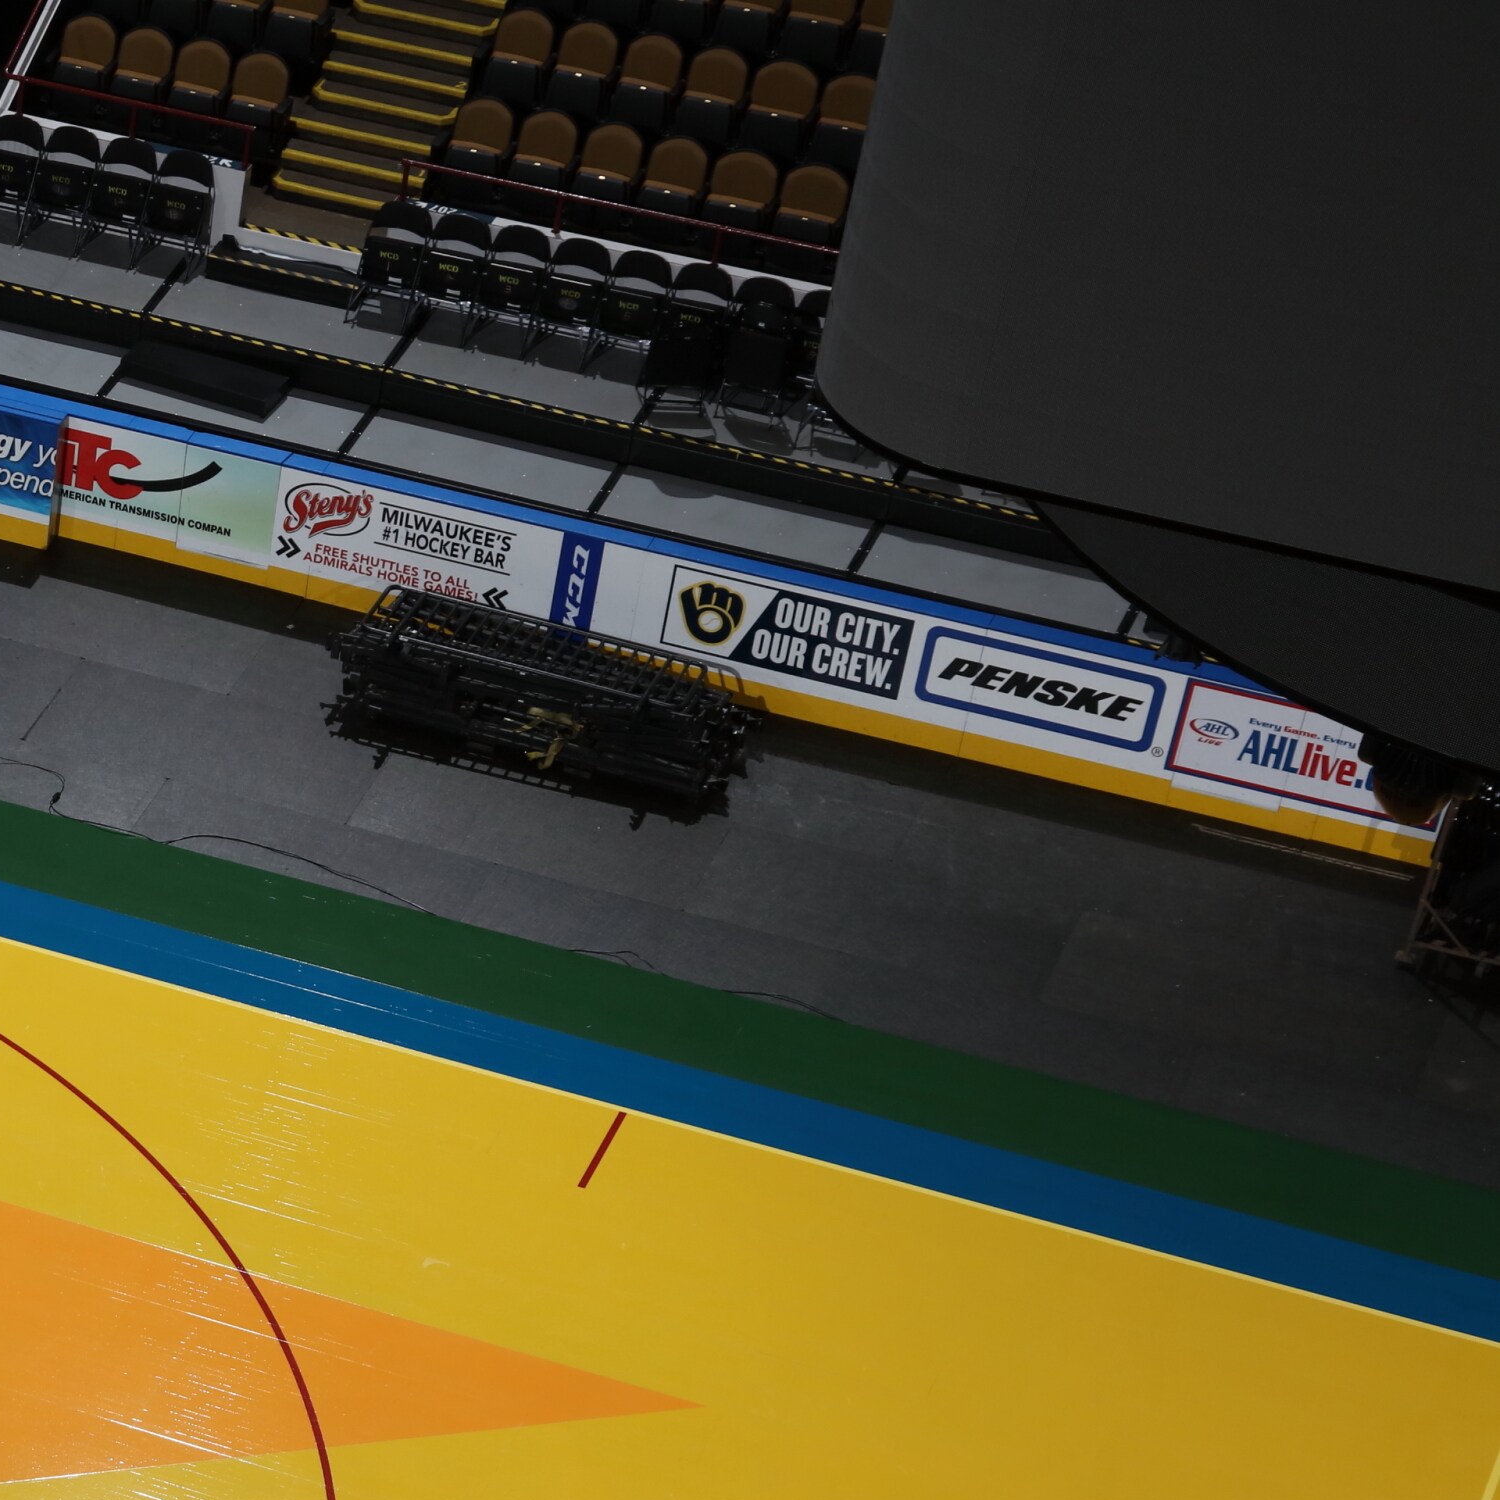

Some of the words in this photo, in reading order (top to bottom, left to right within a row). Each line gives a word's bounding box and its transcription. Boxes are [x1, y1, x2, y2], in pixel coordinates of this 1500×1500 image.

[109, 500, 185, 526] TRANSMISSION
[188, 519, 231, 537] COMPAN
[283, 489, 374, 533] Steny's
[381, 508, 512, 552] MILWAUKEE'S
[315, 543, 348, 559] FREE
[352, 551, 419, 576] SHUTTLES
[423, 569, 442, 581] TO
[446, 575, 470, 590] ALL
[382, 525, 400, 543] #1
[404, 528, 469, 560] HOCKEY
[473, 548, 507, 570] BAR
[302, 553, 374, 577] ADMIRALS
[377, 570, 419, 588] HOME
[423, 580, 478, 602] GAMES!
[563, 544, 590, 627] CCM
[775, 597, 829, 640] OUR
[835, 611, 900, 656] CITY.
[751, 628, 807, 669] OUR
[812, 643, 893, 691] CREW.
[938, 657, 1145, 722] PENSKE
[1198, 737, 1223, 746] LIVE
[1199, 721, 1231, 737] AHL
[1249, 717, 1282, 732] Every
[1283, 726, 1321, 740] Game.
[1323, 735, 1356, 749] Every
